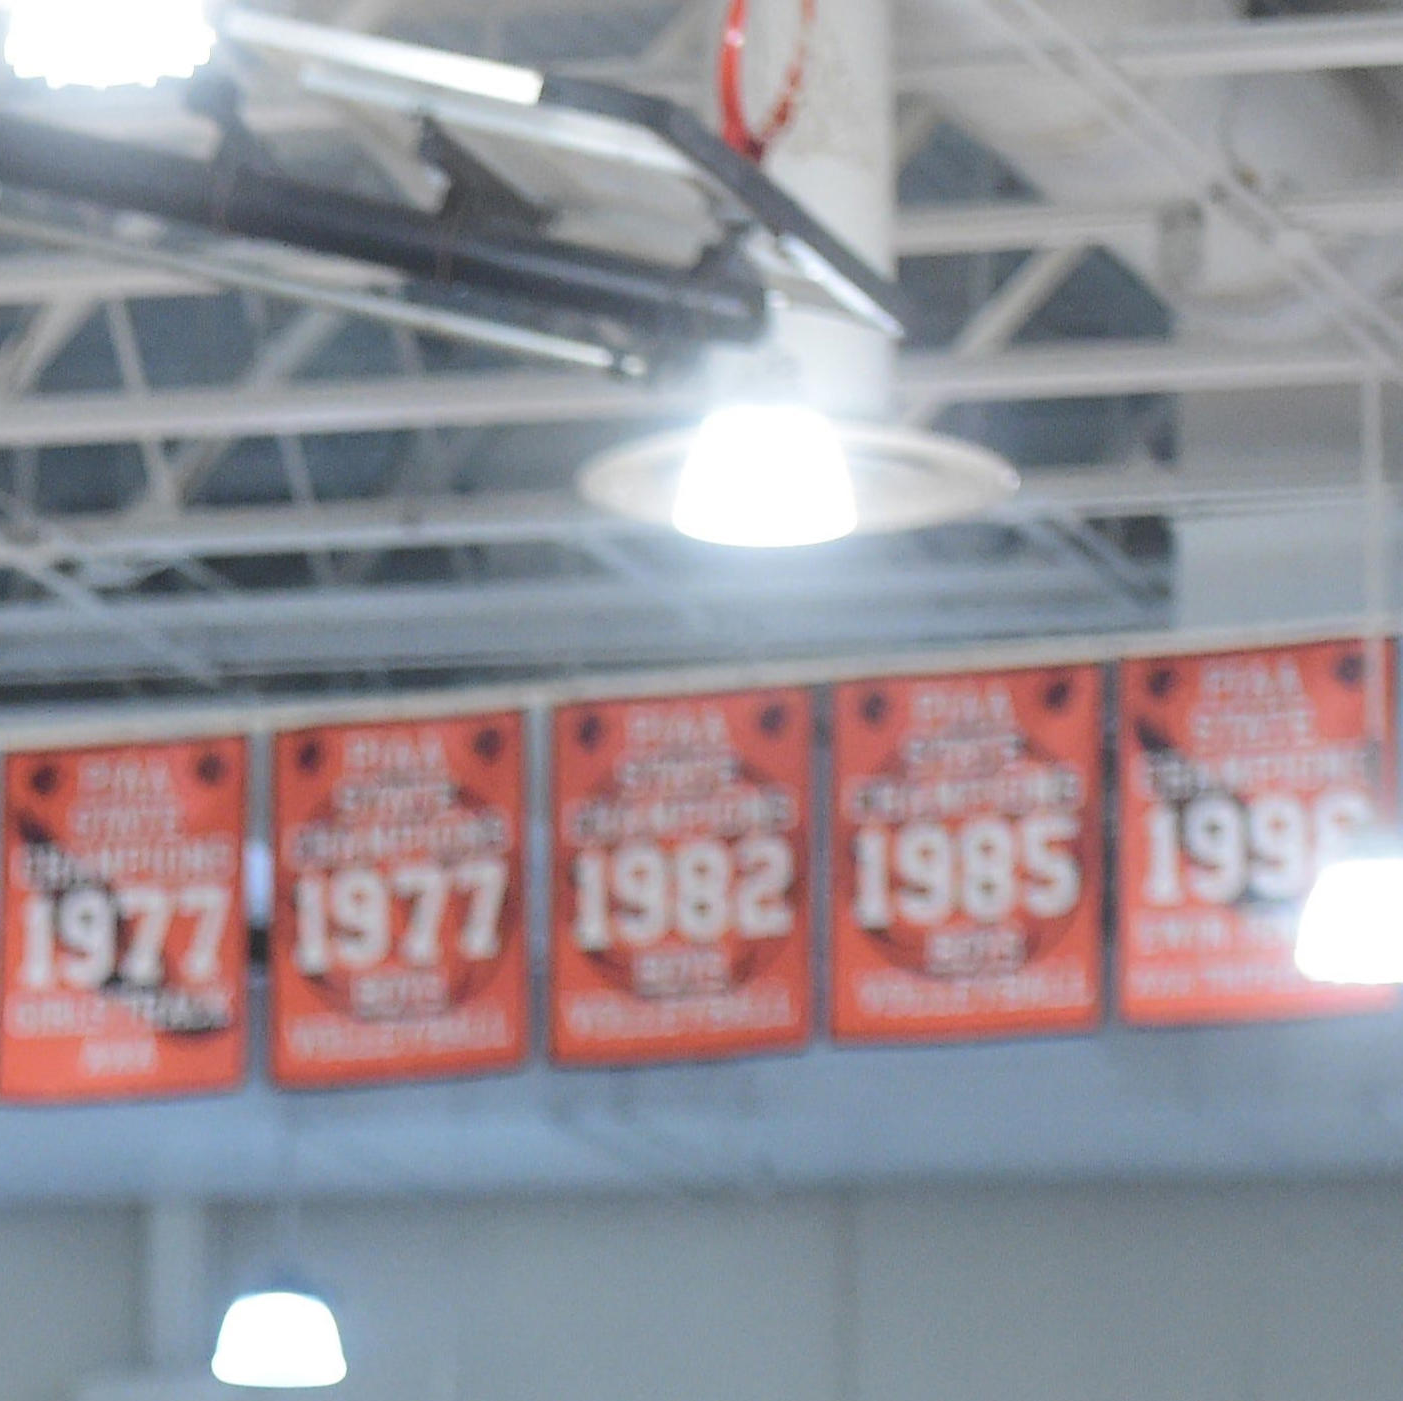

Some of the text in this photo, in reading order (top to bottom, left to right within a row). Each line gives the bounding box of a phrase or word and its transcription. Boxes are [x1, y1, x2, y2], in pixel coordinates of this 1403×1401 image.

[295, 860, 507, 976] 1977
[572, 836, 794, 951] 1982
[853, 815, 1083, 930] 1985
[16, 885, 230, 989] 1977
